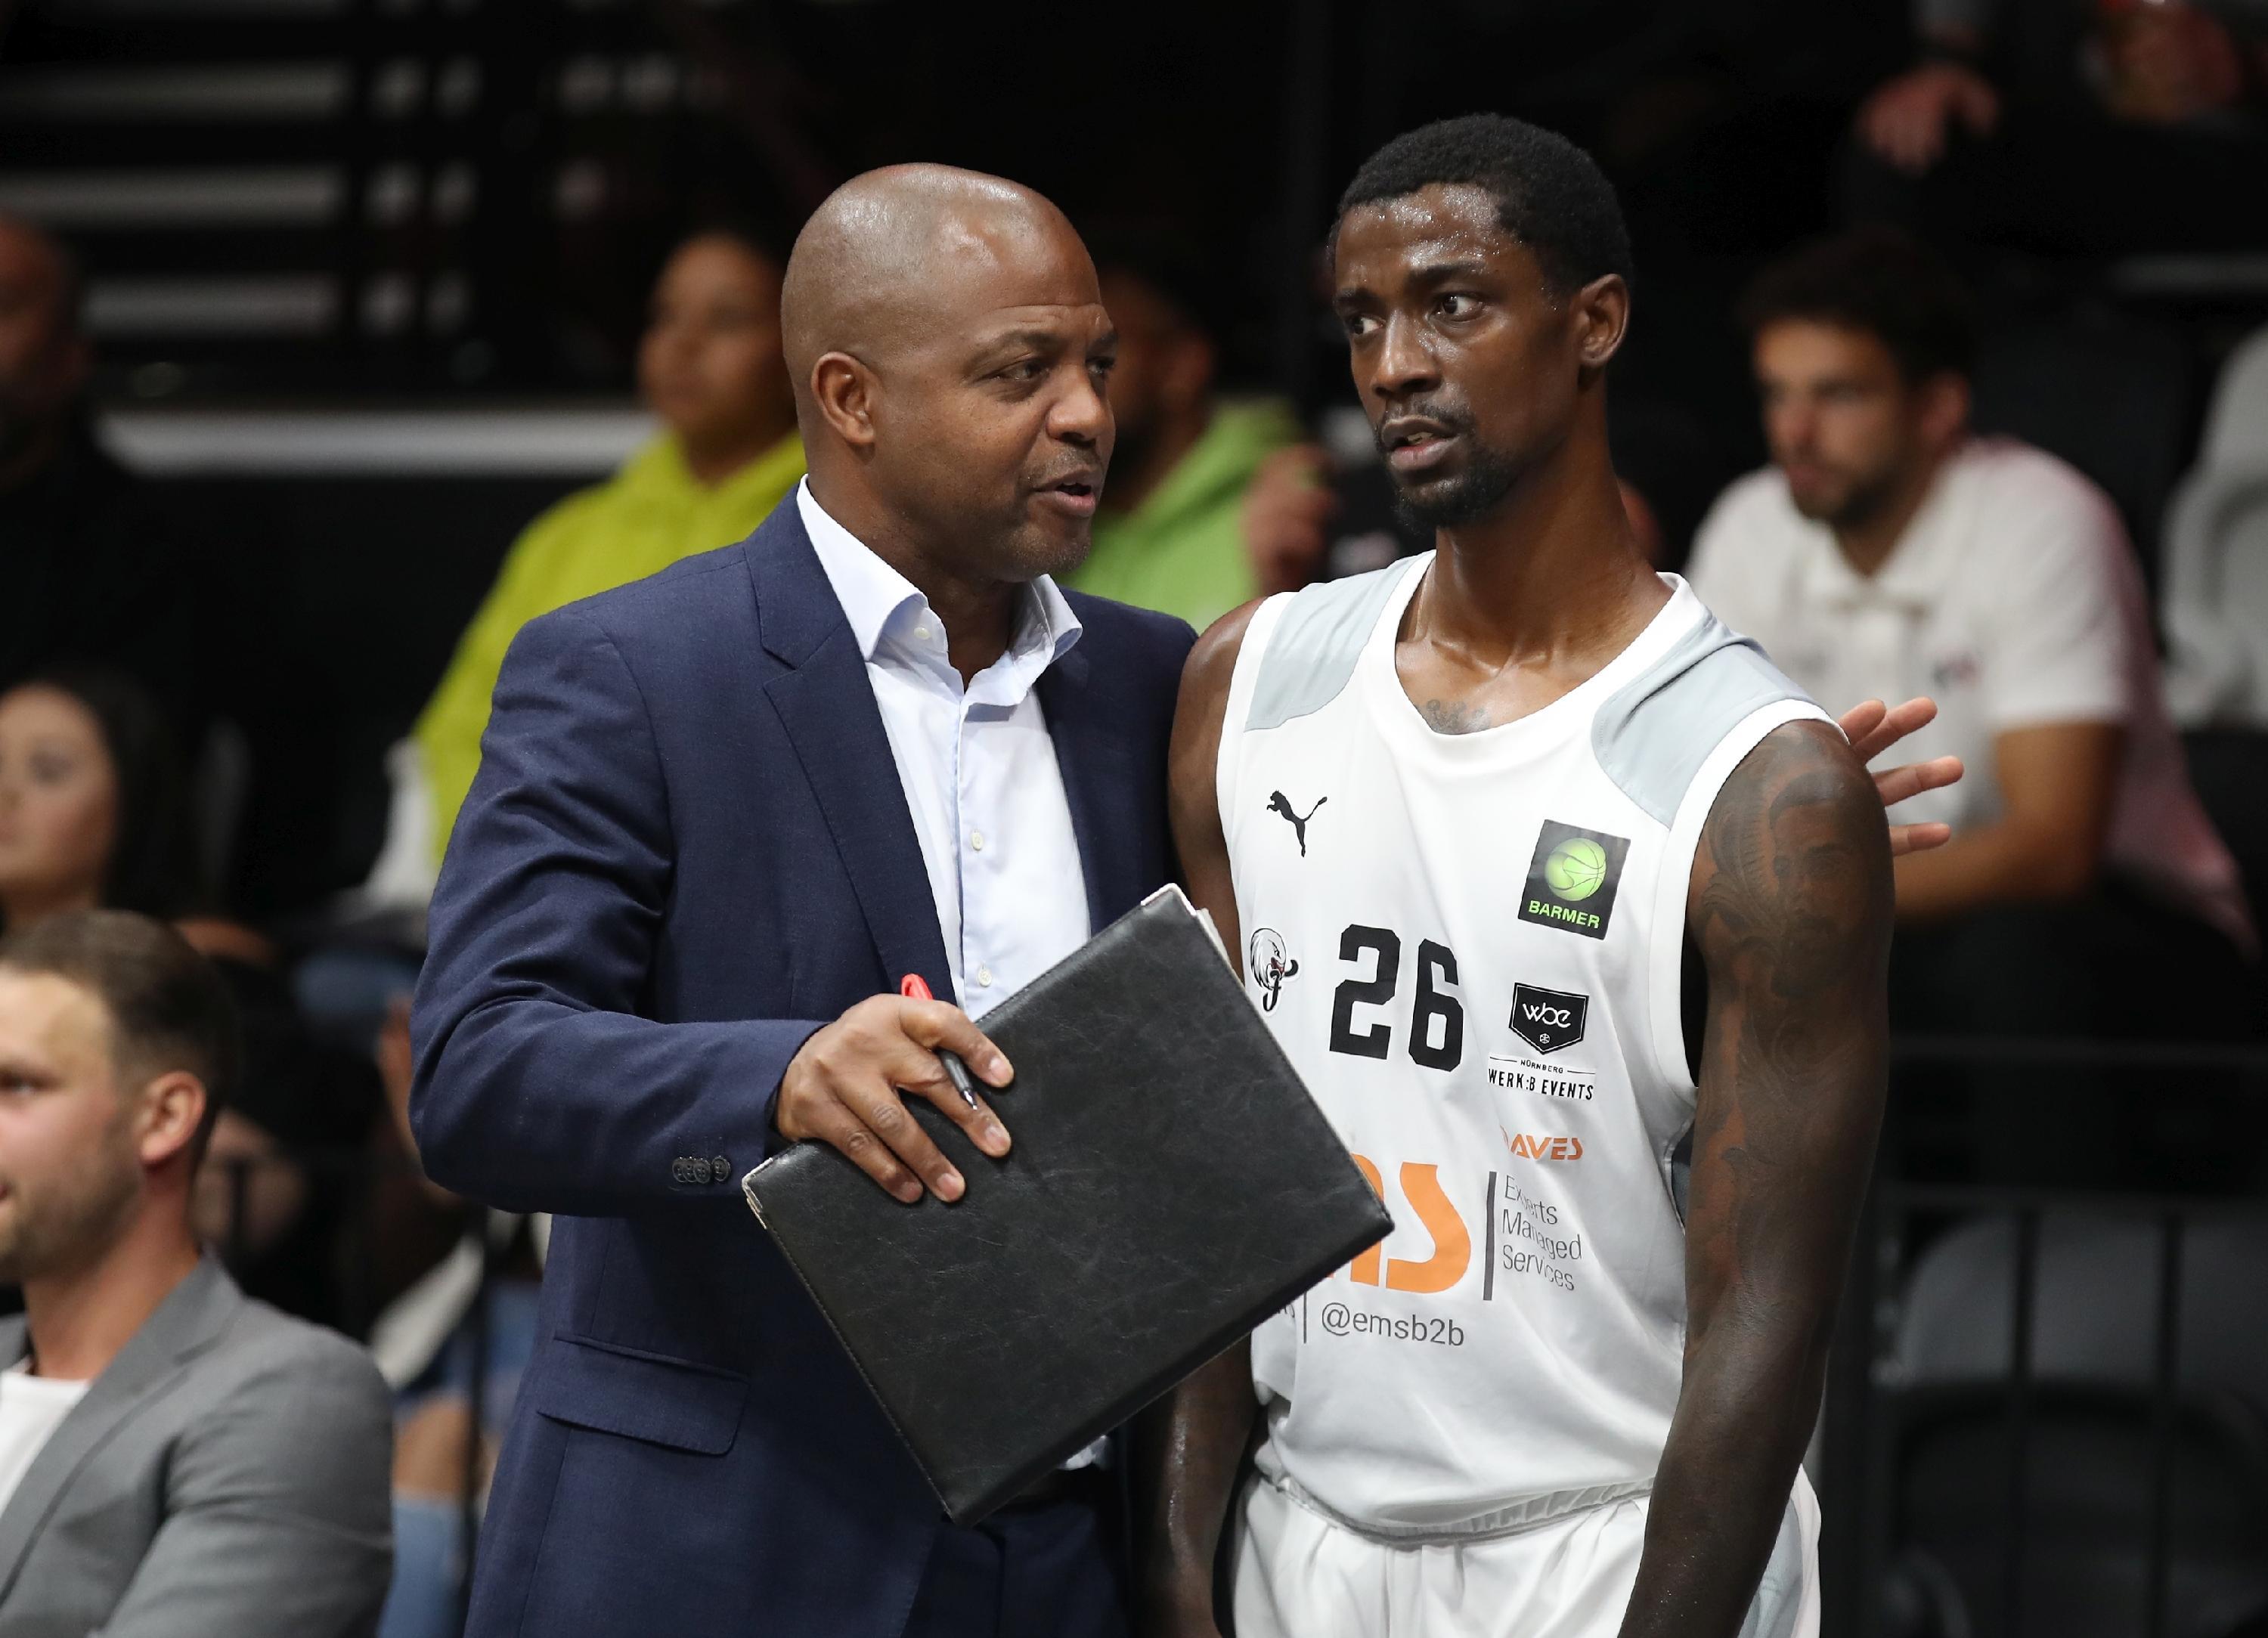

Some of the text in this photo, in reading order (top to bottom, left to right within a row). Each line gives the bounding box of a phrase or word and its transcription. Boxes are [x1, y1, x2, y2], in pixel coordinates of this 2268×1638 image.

[1528, 900, 1601, 929] BARMER
[1329, 924, 1464, 1073] 26
[1541, 1079, 1594, 1101] EVENTS
[1501, 1208, 1583, 1261] Managed
[1502, 1243, 1576, 1292] Services
[1321, 1302, 1465, 1346] @emsb2b
